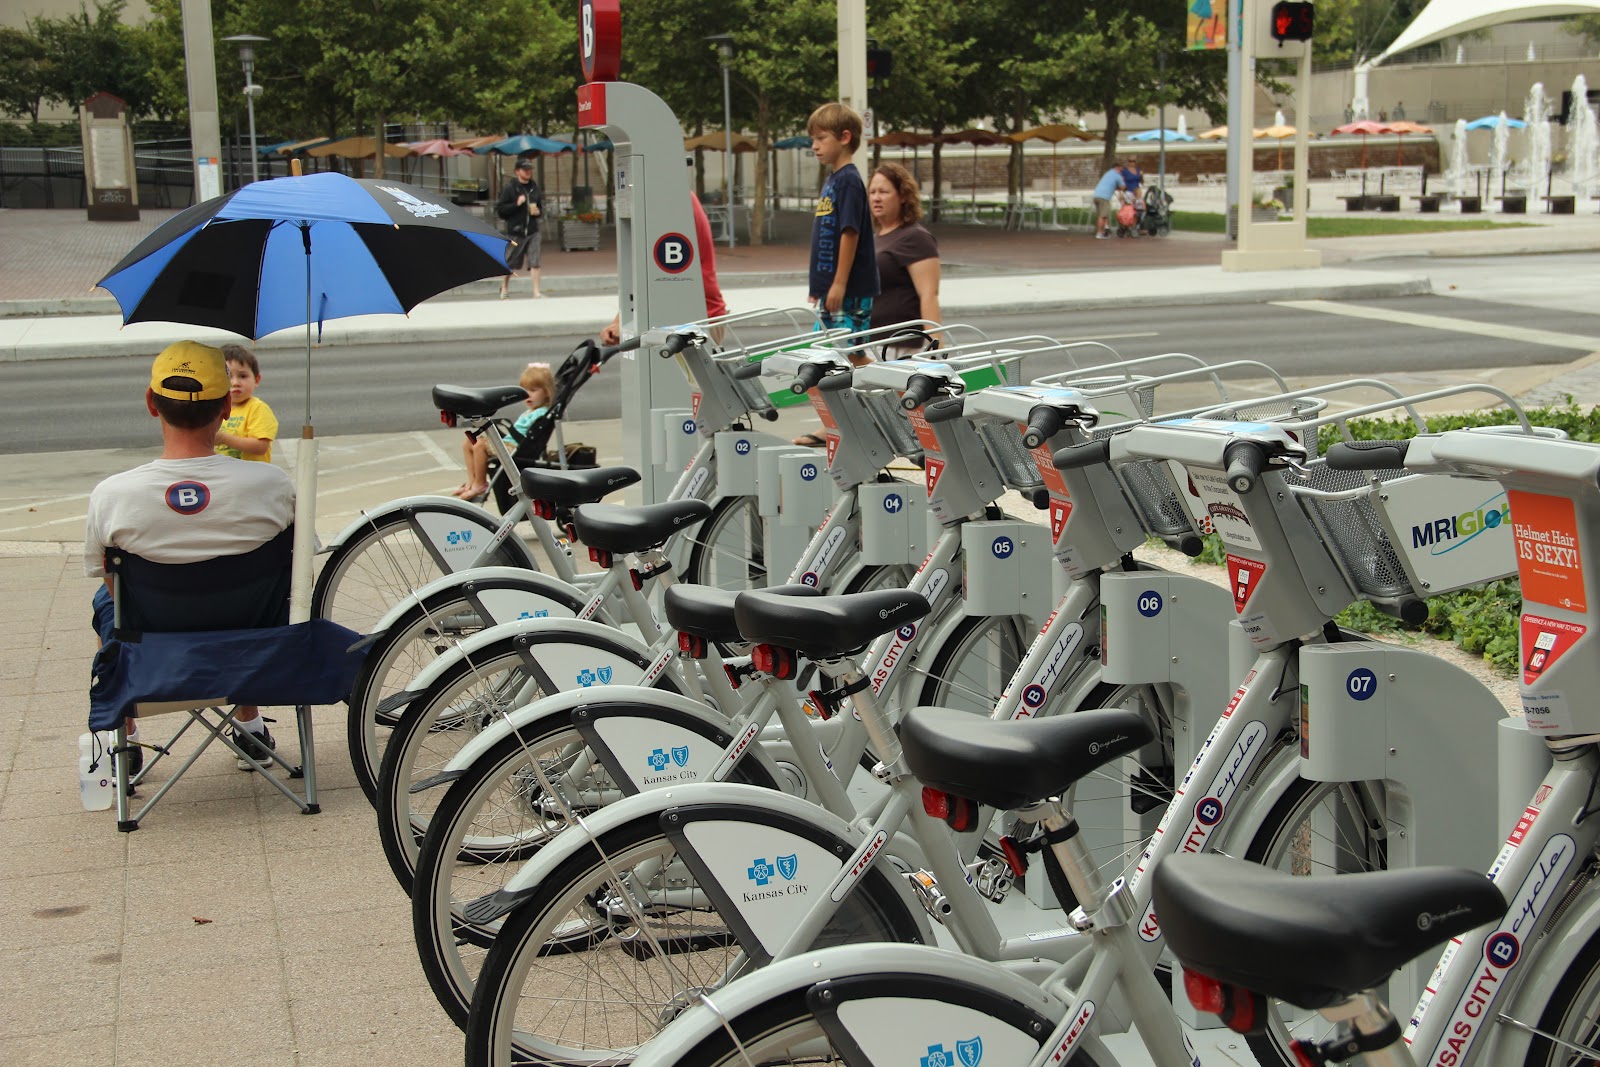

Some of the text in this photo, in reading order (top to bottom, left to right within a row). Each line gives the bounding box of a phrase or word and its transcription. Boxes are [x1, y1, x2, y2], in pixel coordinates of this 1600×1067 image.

[582, 4, 594, 58] B
[665, 242, 683, 264] B
[684, 423, 694, 431] 01
[736, 443, 749, 452] 02
[802, 468, 815, 477] 03
[178, 488, 199, 507] B
[885, 498, 899, 509] 04
[1514, 524, 1575, 547] Helmet Hair
[994, 541, 1010, 554] 05
[1518, 540, 1579, 569] IS SEXY!
[804, 576, 815, 586] B
[582, 598, 601, 620] TREK
[1140, 597, 1159, 611] 06
[900, 626, 912, 638] B
[1524, 616, 1543, 625] EXPERIENCE
[1570, 625, 1584, 633] WORK
[883, 640, 904, 668] CITY
[1040, 629, 1077, 685] cycle
[1530, 653, 1545, 667] KC
[649, 652, 671, 680] TREK
[1350, 676, 1371, 693] 07
[1027, 689, 1041, 703] B
[729, 727, 757, 760] TREK
[1217, 728, 1260, 798] cycle
[643, 770, 698, 785] Kansas City
[1202, 804, 1218, 820] B
[850, 836, 883, 876] TREK
[742, 884, 809, 902] Kansas City
[1512, 845, 1567, 933] cycle
[1492, 941, 1513, 961] B
[1464, 966, 1498, 1018] CITY
[1051, 1008, 1090, 1062] TREK
